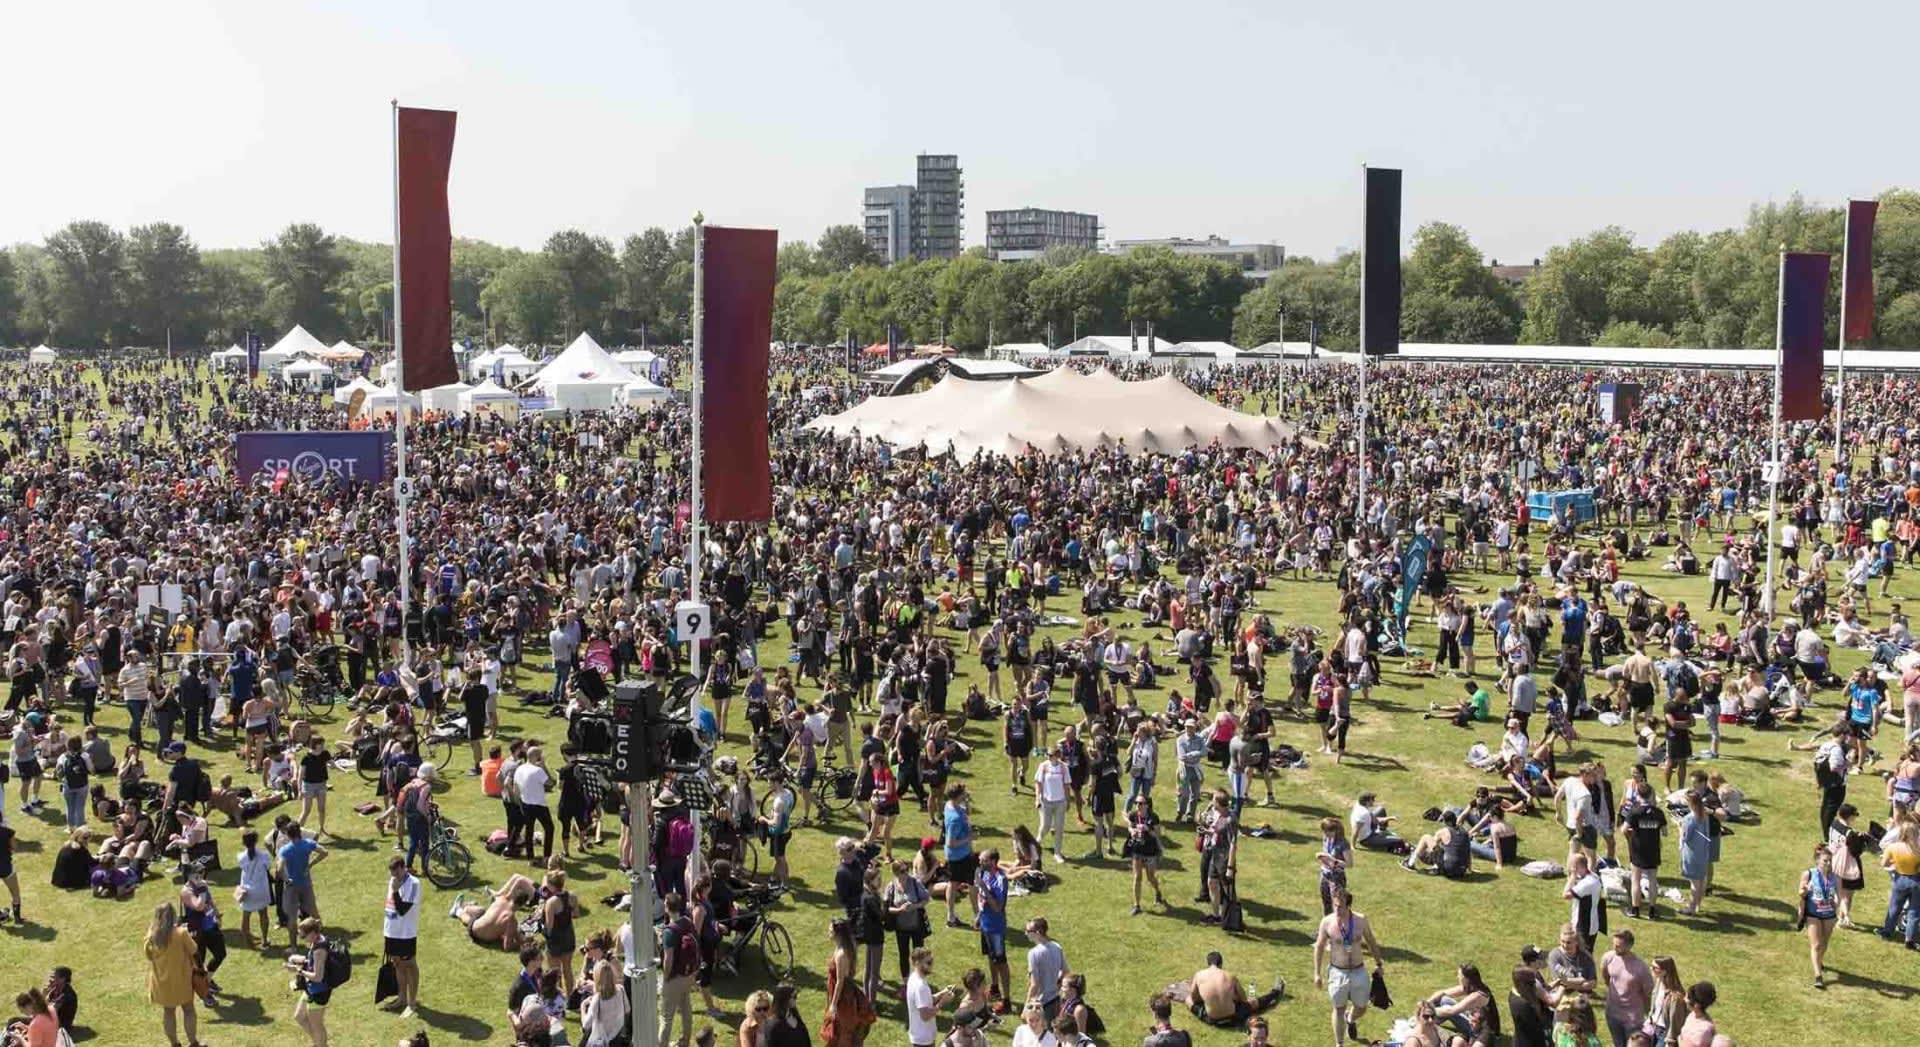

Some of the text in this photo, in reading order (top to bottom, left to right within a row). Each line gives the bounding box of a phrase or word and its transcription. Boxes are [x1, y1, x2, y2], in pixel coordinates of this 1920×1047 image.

[1767, 465, 1774, 477] 7
[400, 481, 409, 495] 8
[686, 613, 701, 634] 9
[616, 724, 630, 770] ECO
